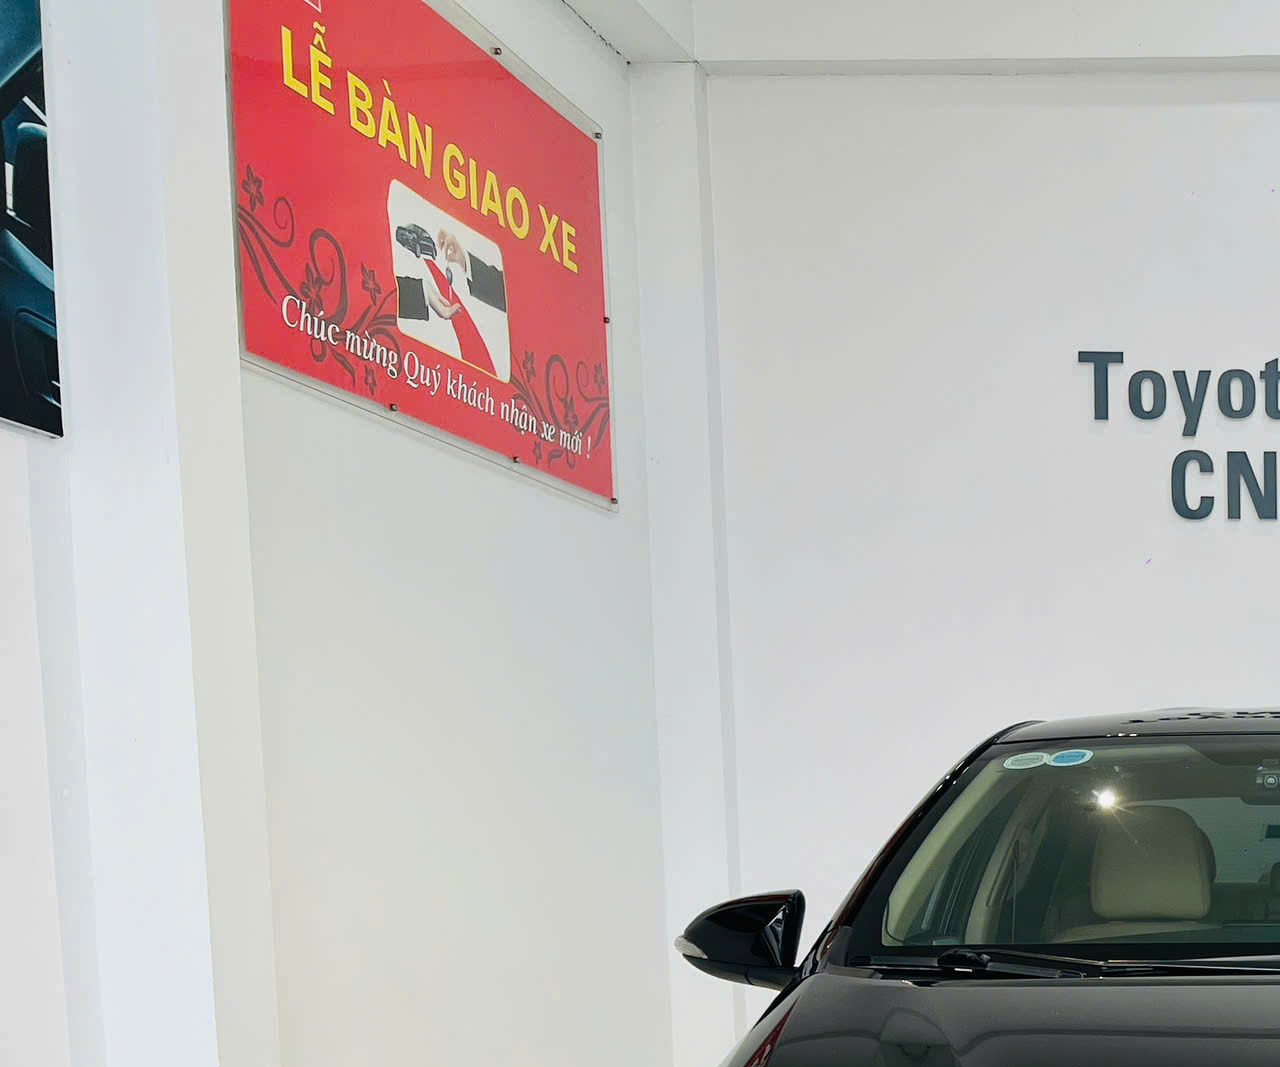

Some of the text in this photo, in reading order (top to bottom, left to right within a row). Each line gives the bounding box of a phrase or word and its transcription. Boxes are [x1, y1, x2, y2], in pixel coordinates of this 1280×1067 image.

[281, 20, 578, 274] LỄ BÀN GIAO XE
[281, 295, 341, 346] Chúc
[344, 327, 399, 379] mừng
[403, 351, 441, 396] Quý
[446, 368, 495, 416] khách
[500, 400, 538, 436] nhận
[540, 420, 556, 442] xe
[559, 429, 583, 456] mới
[1170, 449, 1278, 521] CN
